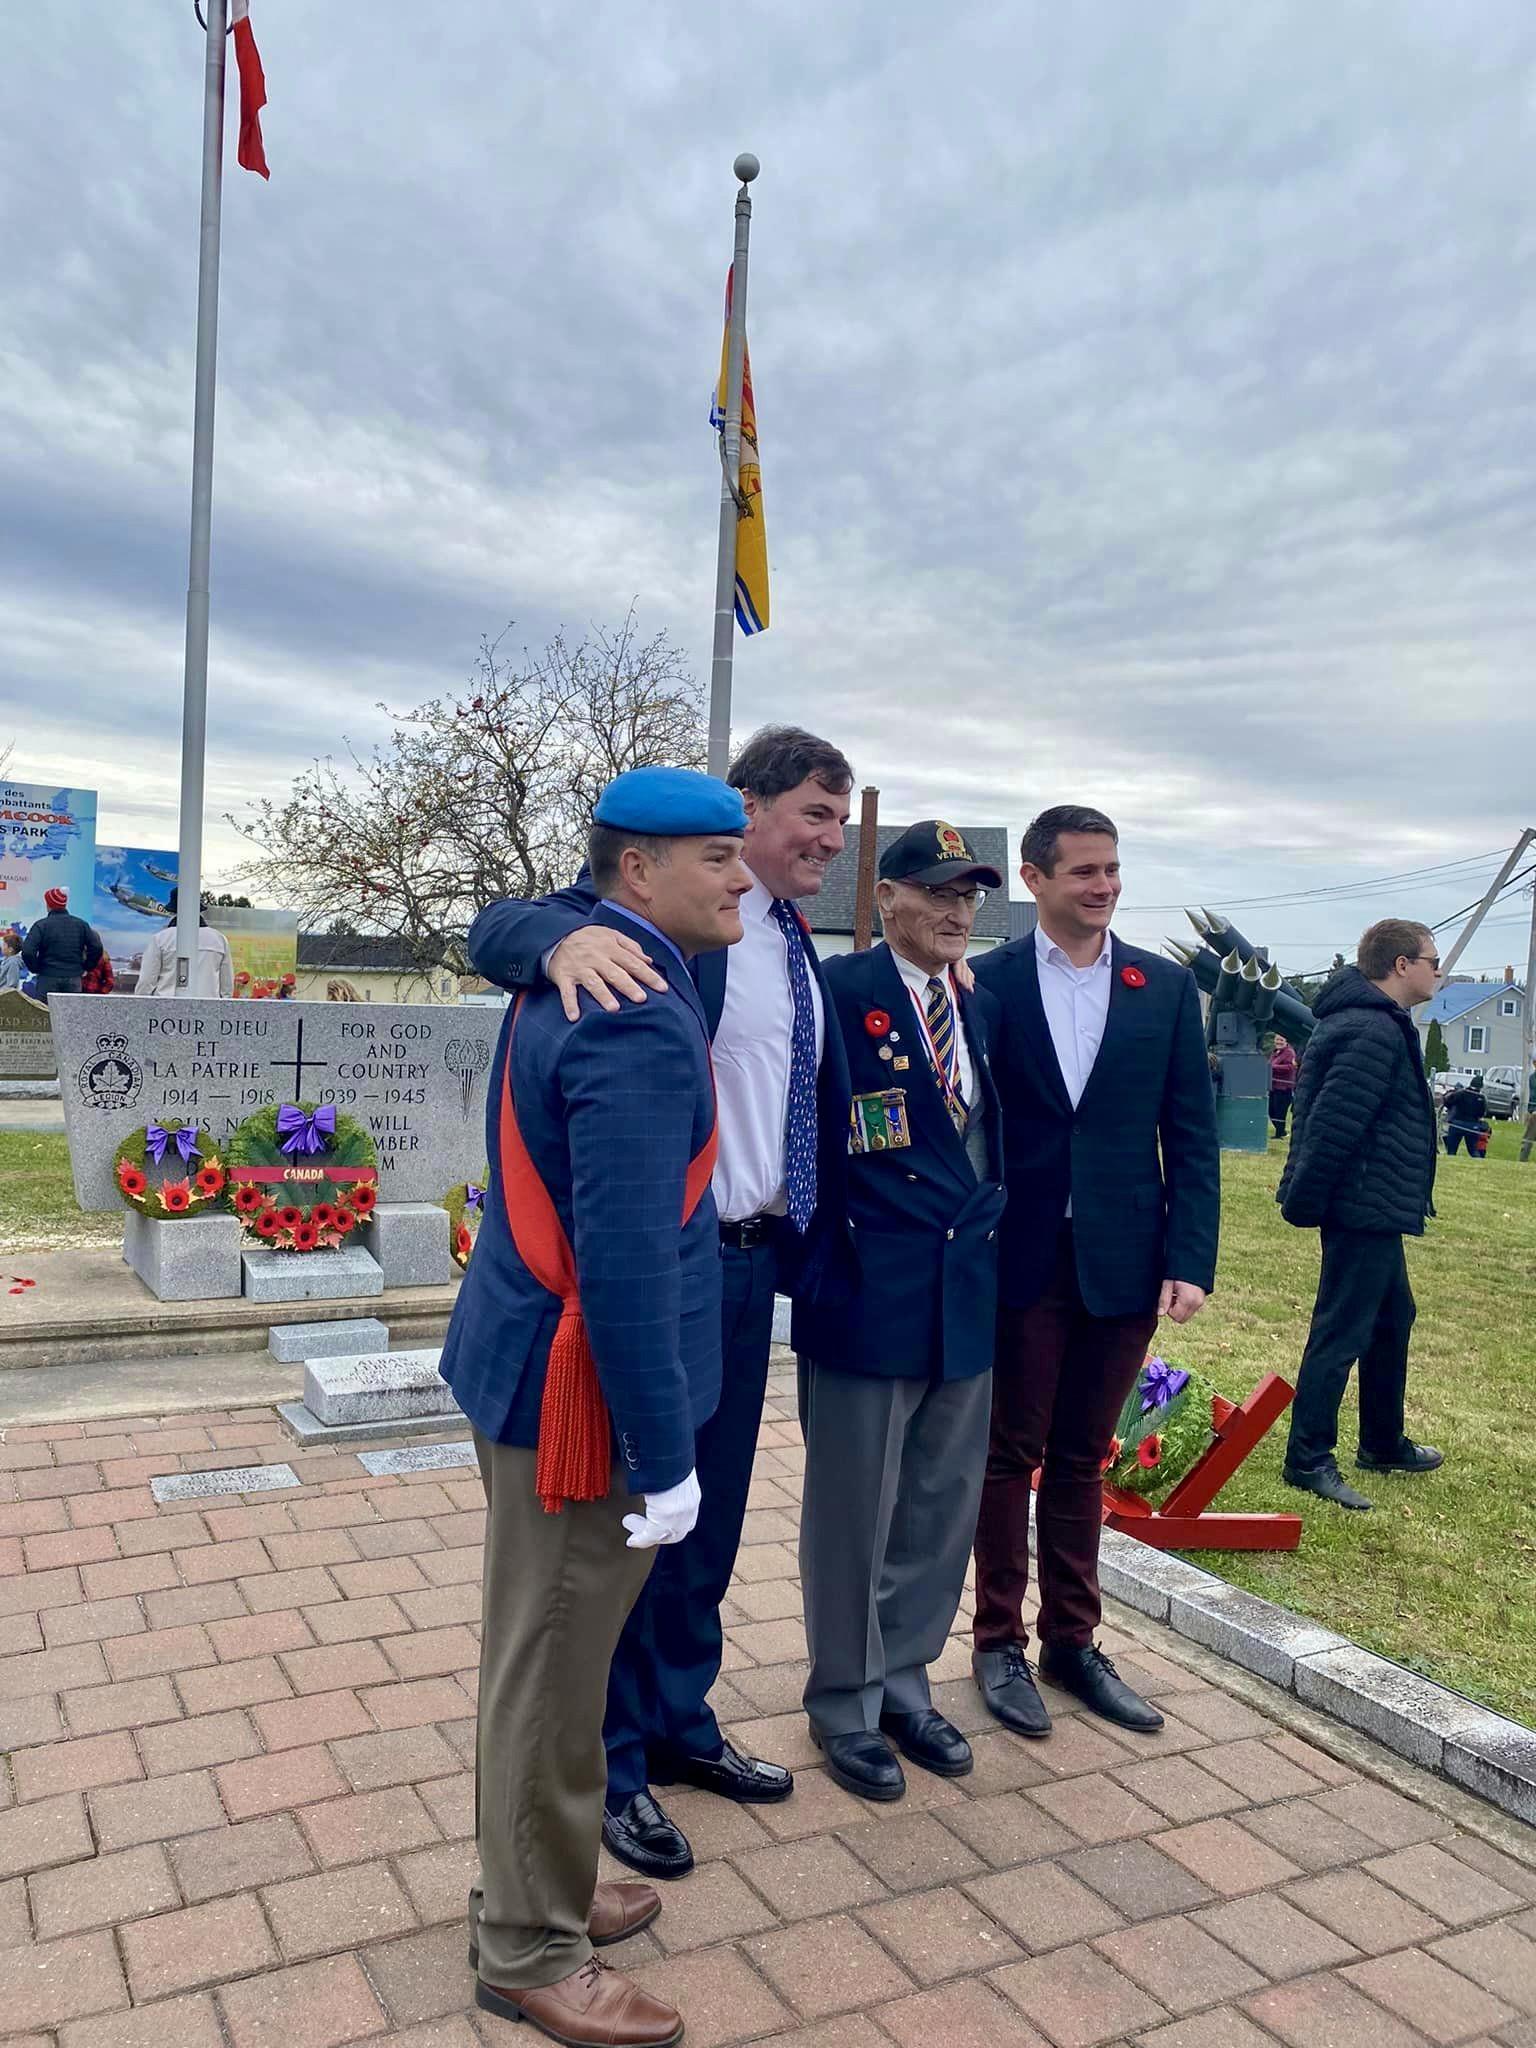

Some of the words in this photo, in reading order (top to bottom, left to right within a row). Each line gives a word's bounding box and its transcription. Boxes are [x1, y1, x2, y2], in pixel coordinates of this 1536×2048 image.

[4, 789, 25, 798] des
[12, 826, 49, 838] PARK
[148, 1018, 205, 1035] POUR
[220, 1020, 268, 1036] DIEU
[341, 1022, 376, 1038] FOR
[390, 1023, 432, 1040] GOD
[196, 1041, 220, 1057] ET
[366, 1043, 407, 1059] AND
[81, 1060, 99, 1089] ROYAL
[153, 1061, 178, 1078] LA
[191, 1062, 261, 1079] PATRIE
[338, 1063, 430, 1080] COUNTRY
[93, 1093, 127, 1102] LEGION
[162, 1088, 199, 1105] 1914
[240, 1088, 275, 1105] 1918
[319, 1088, 357, 1105] 1939
[384, 1088, 426, 1105] 1945
[369, 1115, 412, 1130] WILL
[373, 1136, 420, 1151] MBER
[283, 1168, 325, 1180] CANADA
